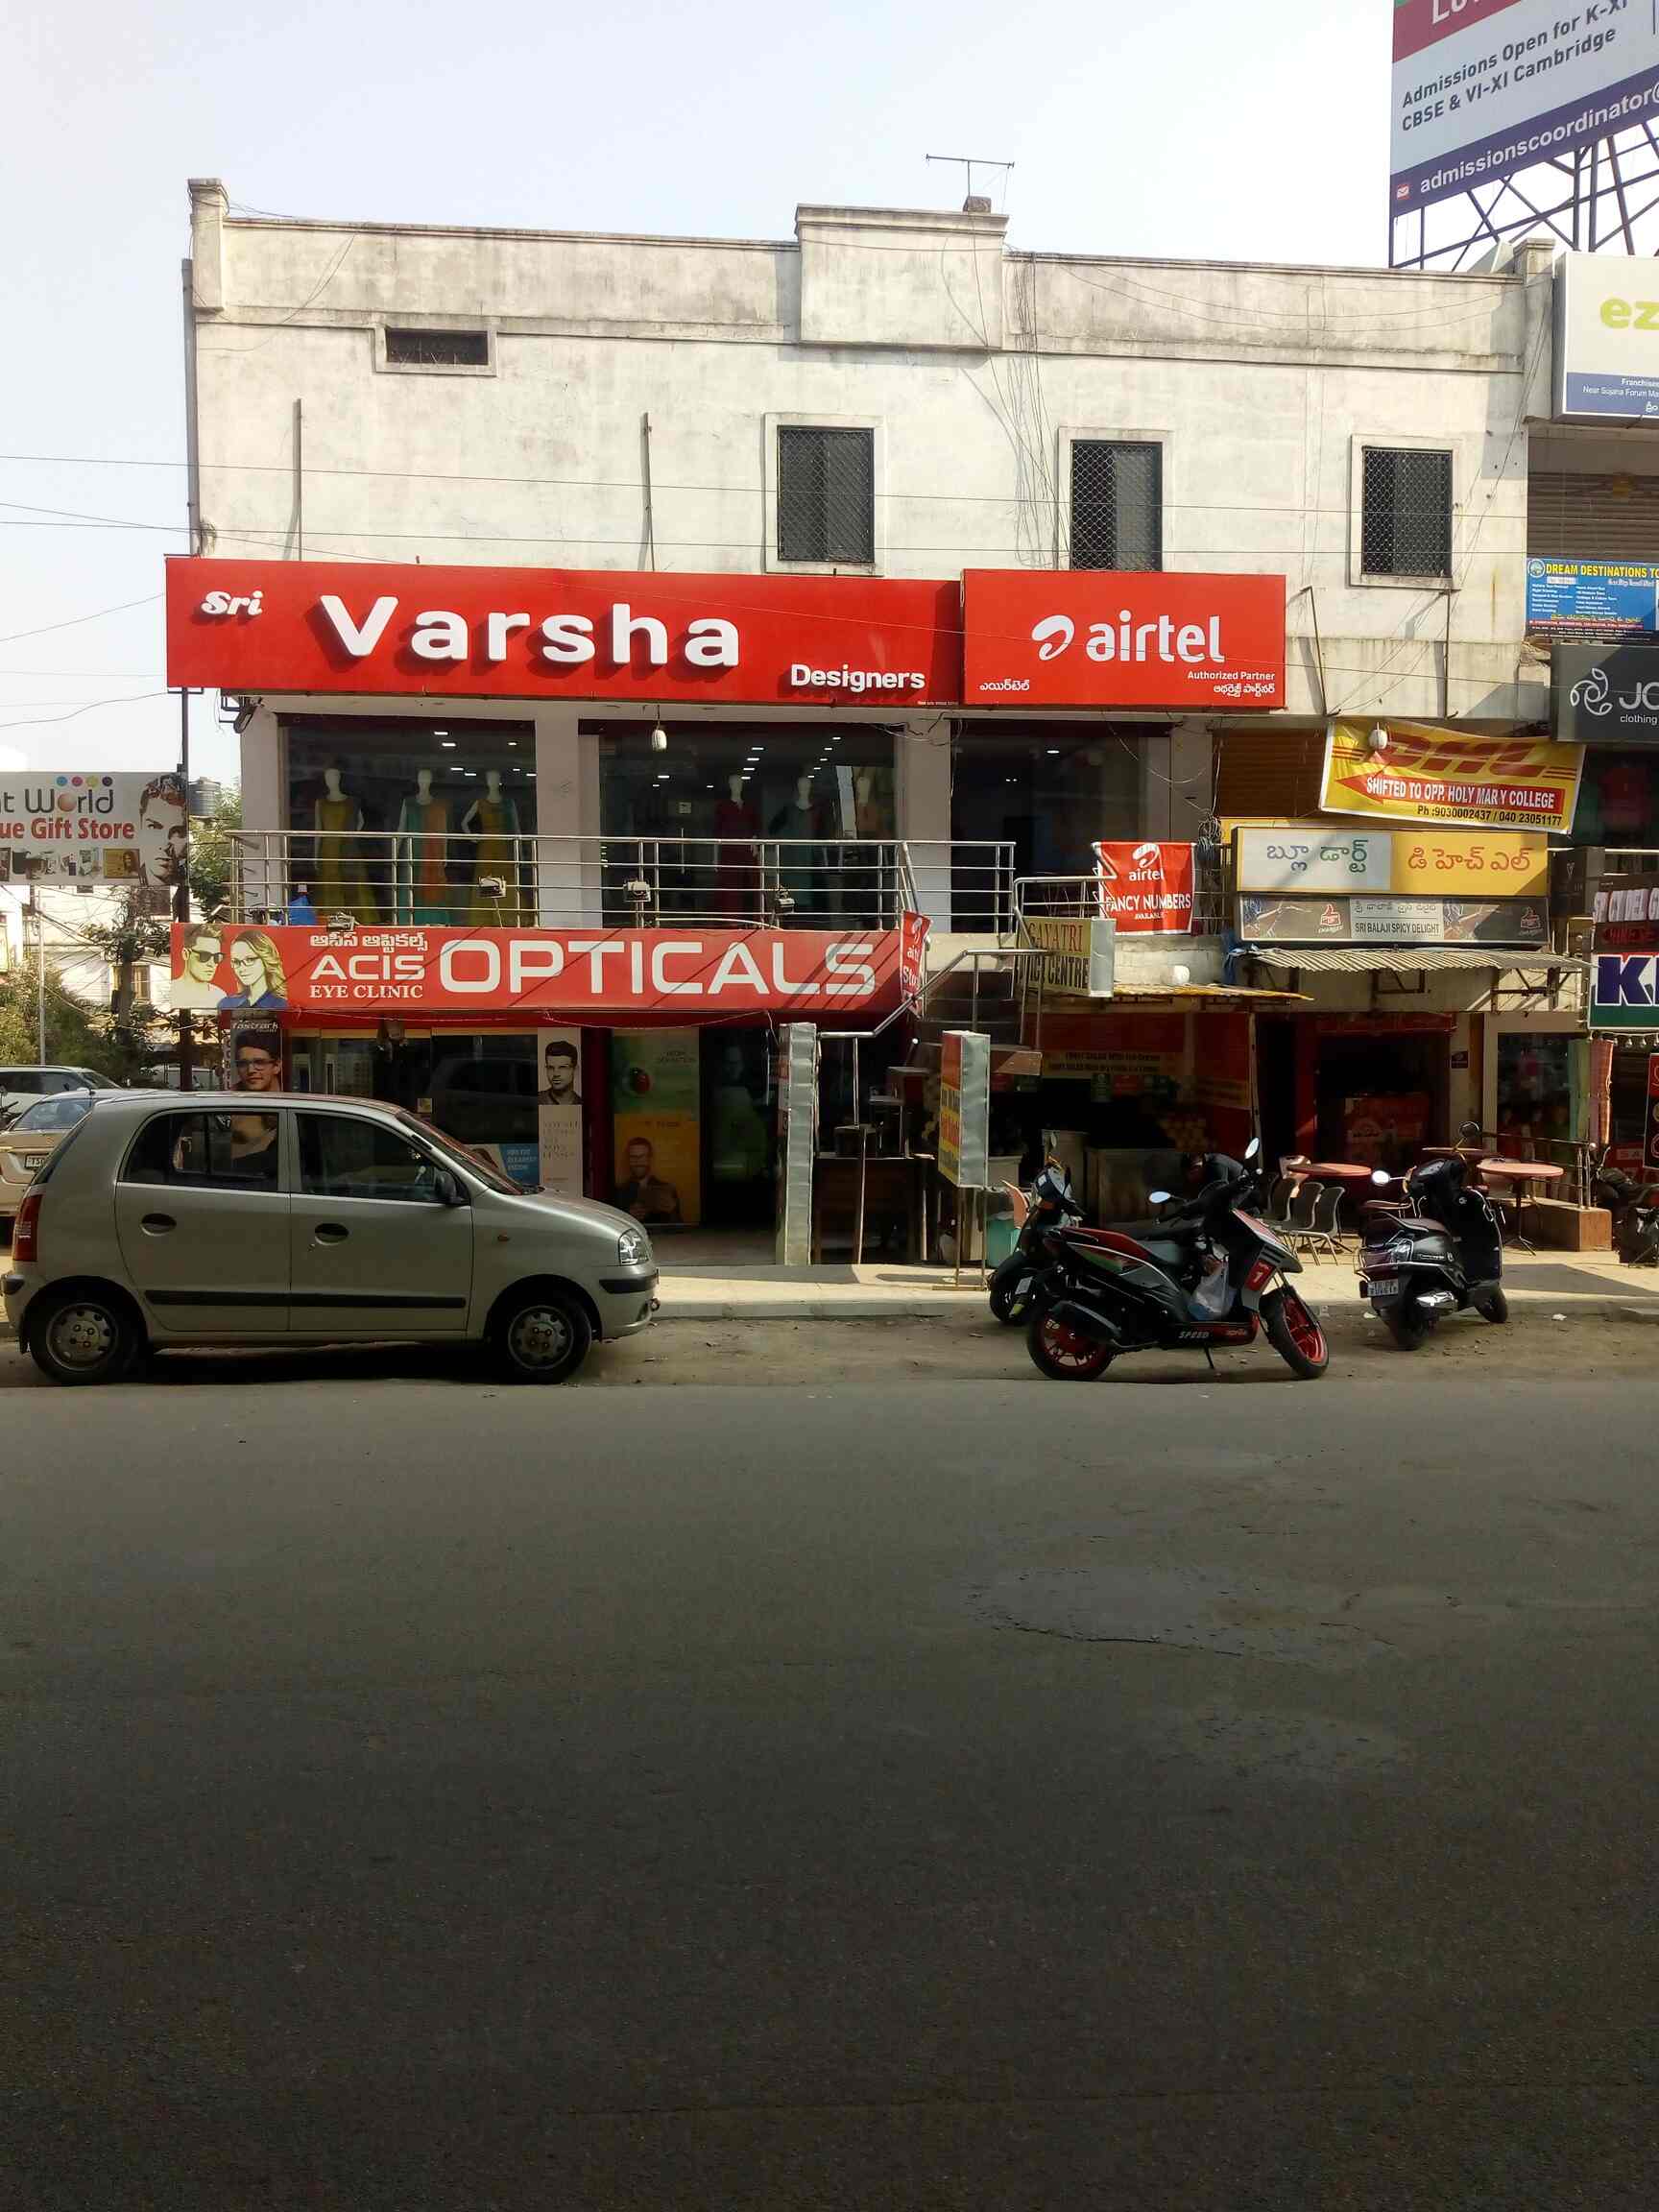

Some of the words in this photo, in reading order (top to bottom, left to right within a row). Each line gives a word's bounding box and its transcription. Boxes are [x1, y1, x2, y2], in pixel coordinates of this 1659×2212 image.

[1402, 54, 1497, 108] Admissions
[1502, 32, 1548, 61] Open
[1552, 16, 1580, 39] for
[1402, 102, 1445, 132] CBSE
[1449, 94, 1461, 111] &
[1465, 71, 1508, 103] VI-XI
[1513, 28, 1616, 83] Cambridge
[1546, 564, 1577, 575] DREAM
[1581, 565, 1647, 577] DESTINATIONS
[201, 589, 263, 616] Sri
[320, 594, 739, 667] Varsha
[1086, 610, 1226, 663] airtel
[791, 663, 926, 693] Designers
[1188, 670, 1238, 680] Authorized
[1240, 671, 1275, 681] Partner
[1620, 713, 1658, 726] clothing
[1366, 777, 1406, 799] SHIFTED
[1408, 781, 1421, 799] TO
[1424, 783, 1445, 801] OPP.
[1448, 785, 1476, 805] HOLY
[1508, 789, 1554, 809] COLLEGE
[31, 818, 73, 840] Gift
[78, 818, 134, 840] Store
[1499, 811, 1516, 823] 040
[1518, 812, 1562, 826] 23051177
[1129, 868, 1165, 881] airtel
[1105, 894, 1141, 912] FANCY
[1143, 894, 1190, 910] NUMBERS
[1027, 922, 1084, 952] GAYATRI
[1355, 922, 1365, 933] SRI
[1367, 922, 1390, 934] BALAJI
[1391, 922, 1410, 933] SPICY
[1411, 923, 1439, 934] DELIGHT
[310, 954, 425, 980] ACIS
[439, 939, 876, 996] OPTICALS
[1048, 955, 1090, 989] CENTRE
[309, 985, 349, 998] EYE
[353, 985, 423, 998] CLINIC
